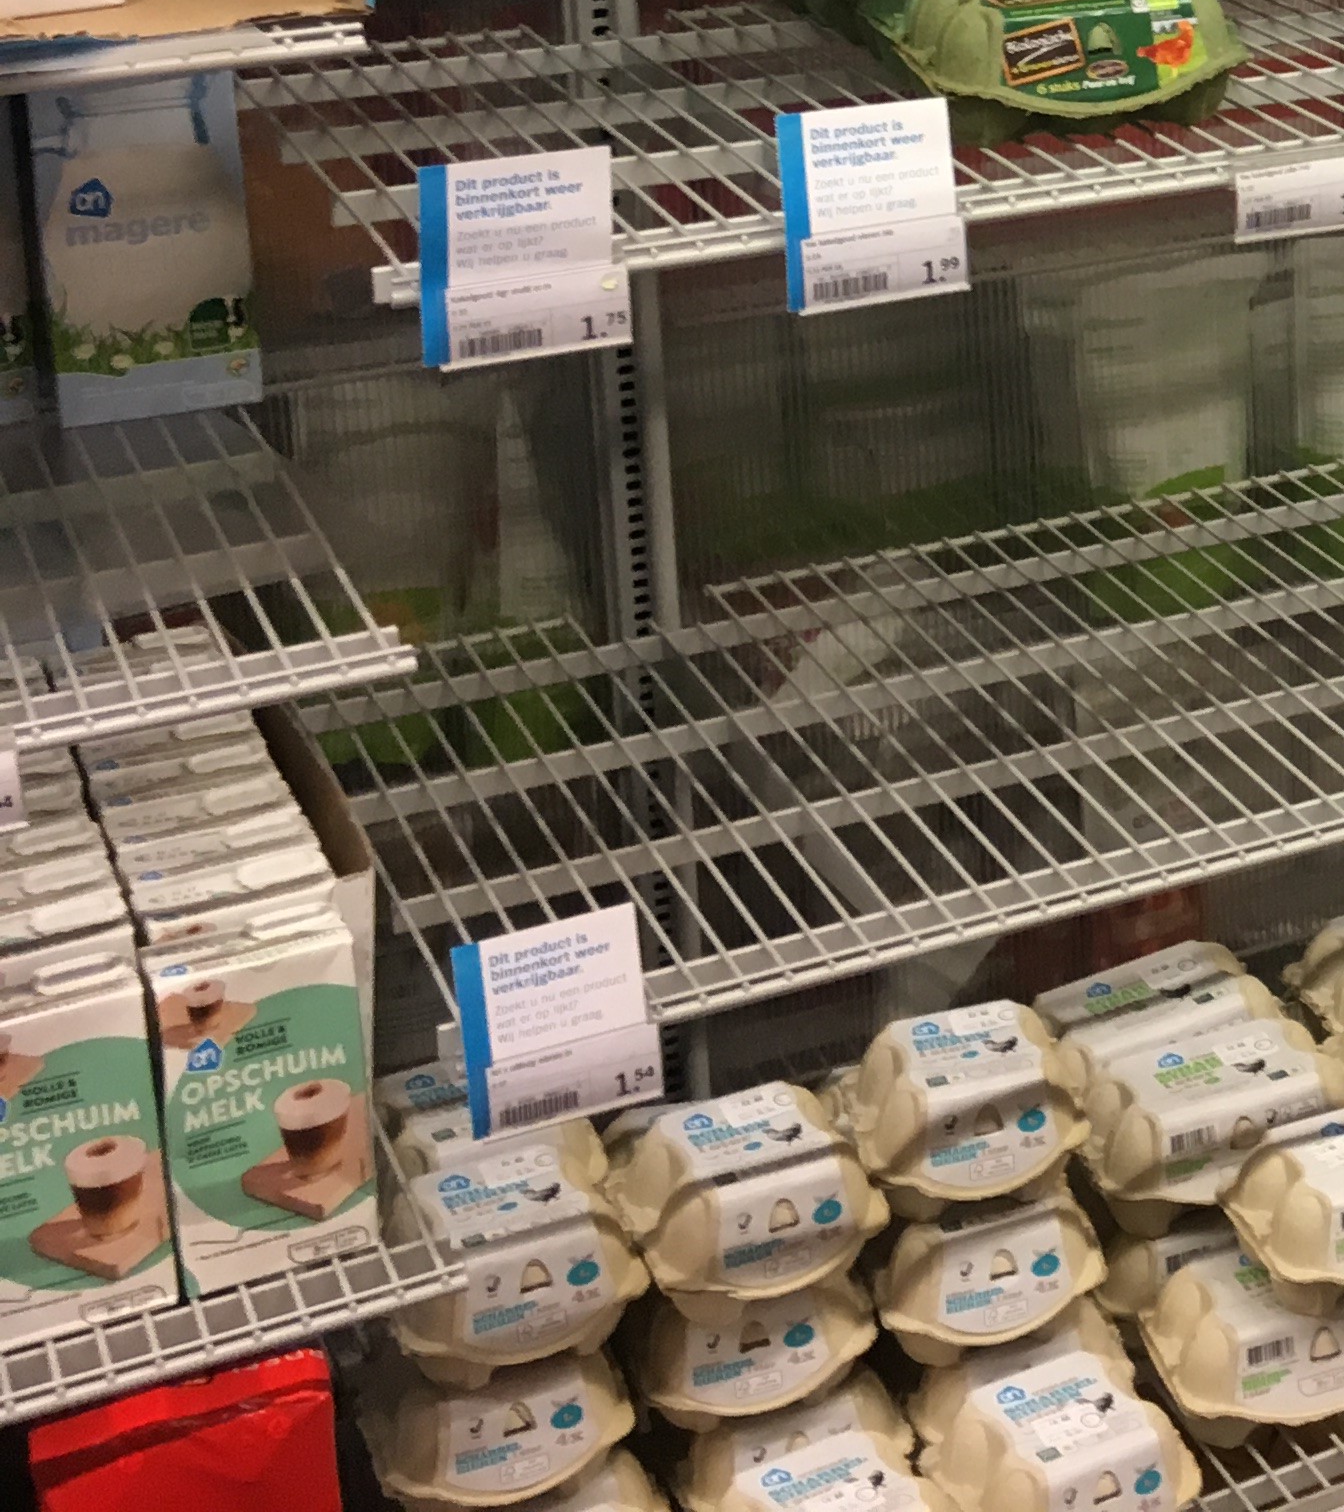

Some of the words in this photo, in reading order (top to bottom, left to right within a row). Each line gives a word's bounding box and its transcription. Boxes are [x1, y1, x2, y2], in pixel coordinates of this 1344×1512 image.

[1049, 80, 1080, 93] stuks
[809, 127, 830, 140] Dit
[834, 121, 889, 139] product
[892, 119, 904, 131] is
[811, 136, 886, 155] binnenkort
[891, 133, 924, 145] weer
[455, 177, 477, 192] Dit
[481, 170, 543, 191] product
[547, 168, 560, 181] is
[814, 175, 844, 190] Zoekt
[898, 166, 940, 181] product
[455, 187, 540, 207] binnenkort
[545, 182, 583, 196] weer
[65, 210, 211, 247] magere
[551, 216, 597, 232] product
[921, 256, 960, 285] 1.99
[580, 311, 627, 340] 1.75
[487, 953, 510, 968] Dit
[514, 936, 572, 963] product
[575, 932, 588, 945] is
[490, 952, 571, 982] binnenkort
[575, 941, 611, 959] weer
[495, 999, 526, 1017] Zoekt
[541, 993, 556, 1004] nu
[560, 986, 580, 999] een
[583, 972, 628, 995] product
[496, 1017, 516, 1030] wat
[535, 1008, 549, 1021] op
[497, 1031, 515, 1044] Wij
[518, 1021, 557, 1038] helpen
[181, 1044, 347, 1105] OPSCHUIM
[183, 1089, 266, 1134] MELK
